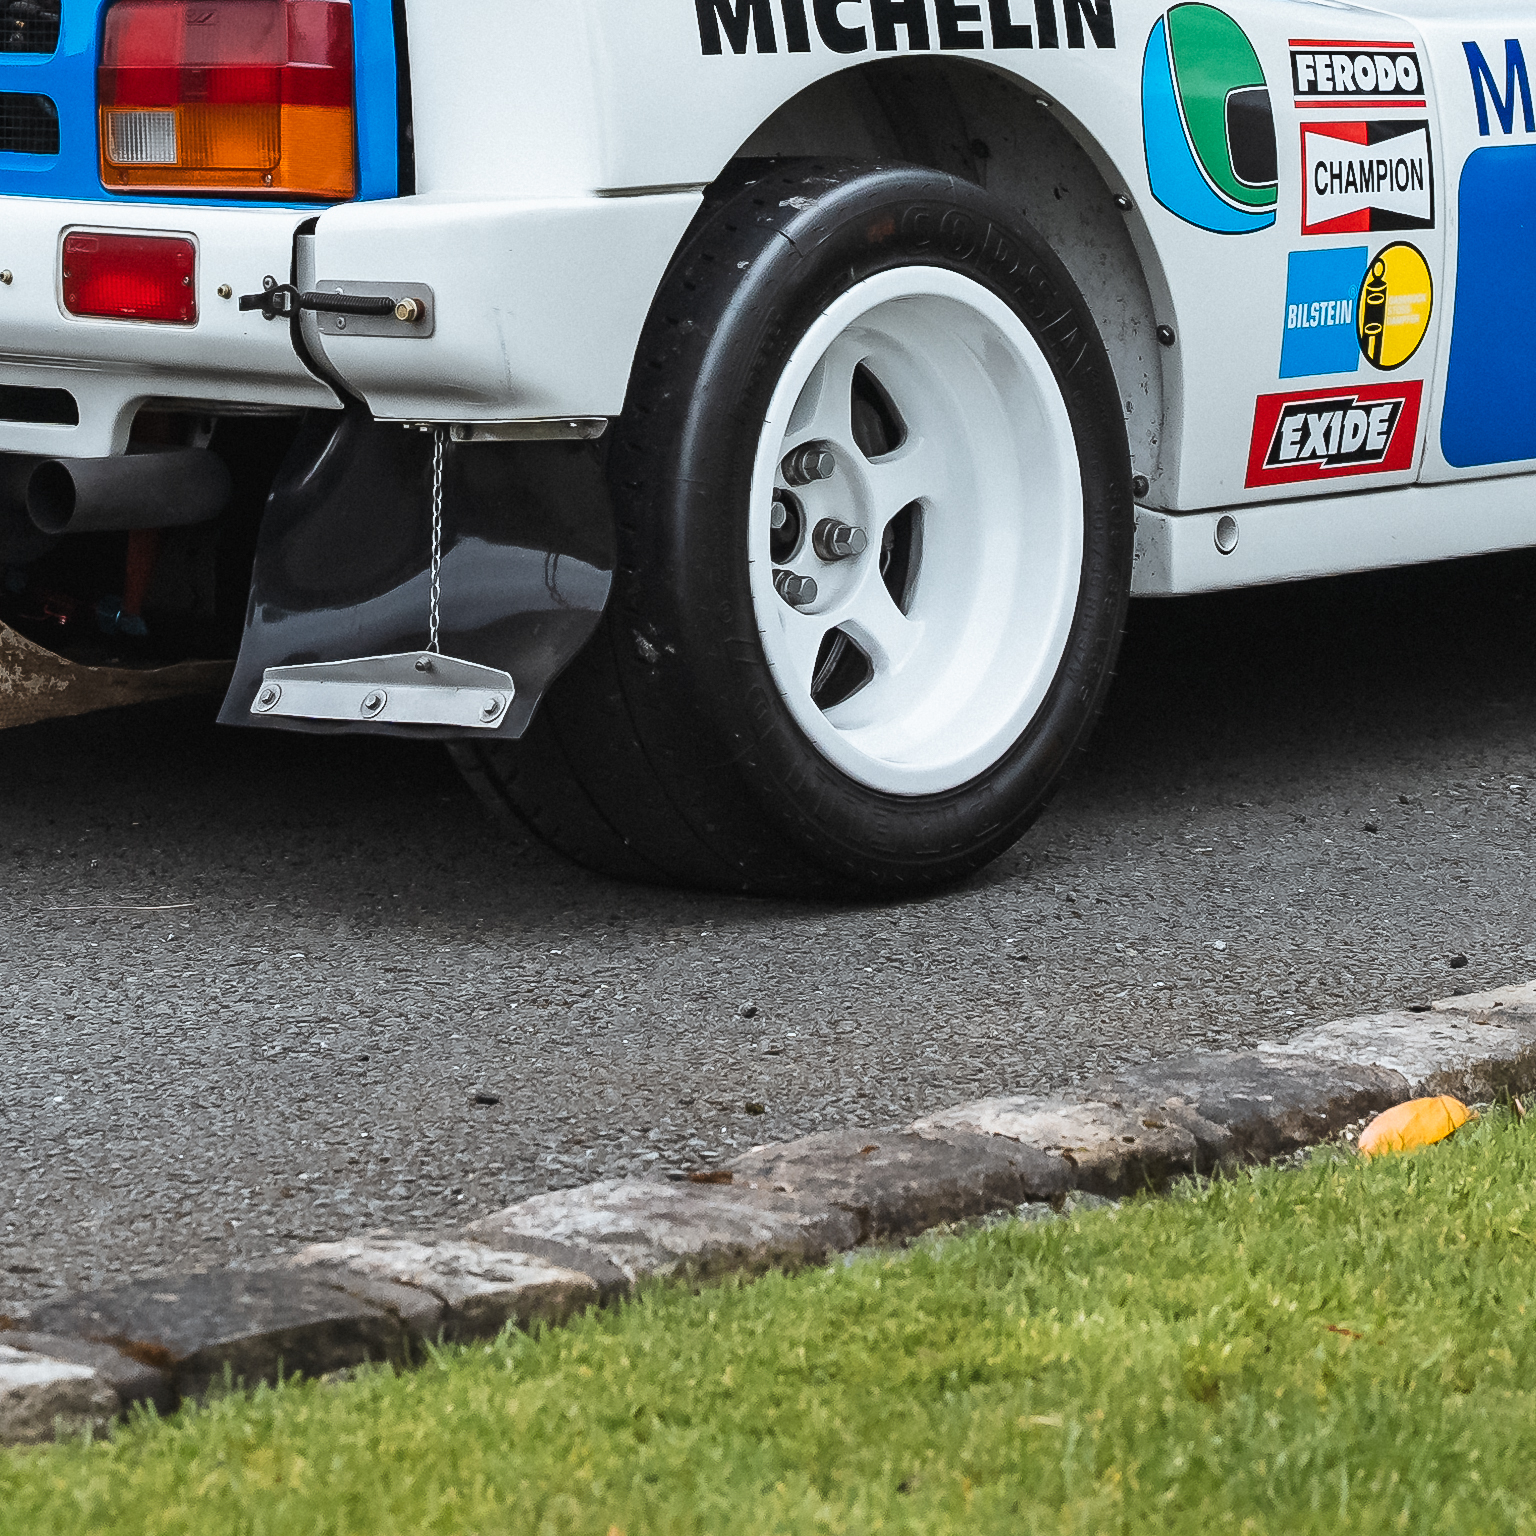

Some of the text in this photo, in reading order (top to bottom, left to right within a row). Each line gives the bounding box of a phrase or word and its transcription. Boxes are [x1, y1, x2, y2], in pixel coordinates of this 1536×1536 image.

[1295, 54, 1419, 92] FERODO
[1314, 157, 1424, 196] CHAMPION
[1287, 299, 1353, 329] BILSTEIN
[1279, 404, 1394, 461] EXIDE
